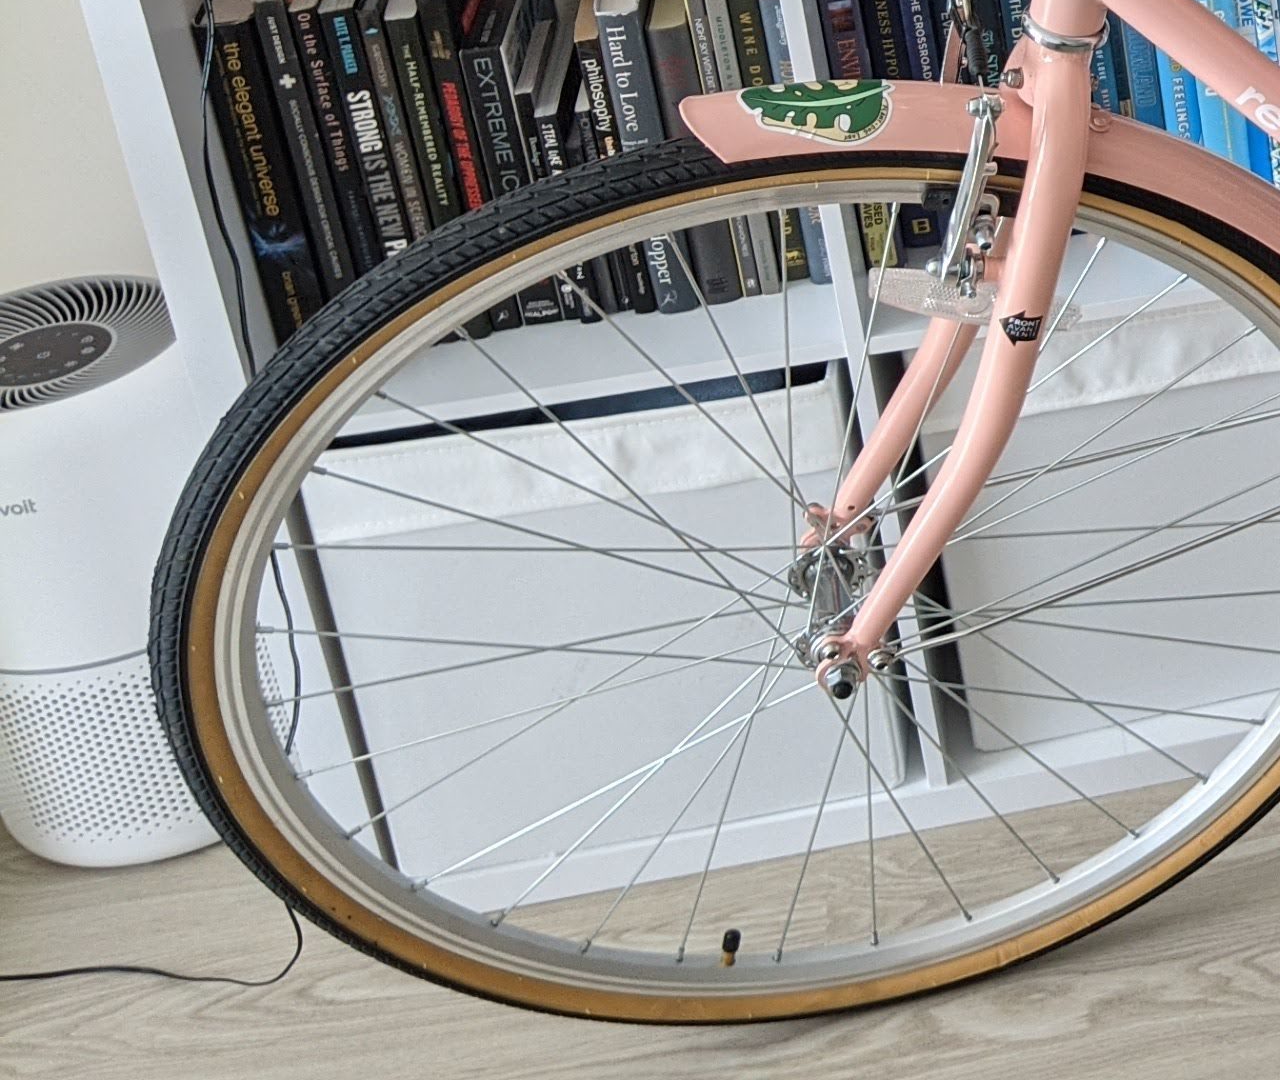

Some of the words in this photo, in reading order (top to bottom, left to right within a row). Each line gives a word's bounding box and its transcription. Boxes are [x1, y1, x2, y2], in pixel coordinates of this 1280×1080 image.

[297, 12, 310, 29] On
[694, 17, 706, 41] NIGHT
[1239, 3, 1254, 27] WE
[303, 34, 317, 55] the
[606, 25, 633, 68] Hard
[698, 41, 709, 55] SKY
[715, 16, 731, 69] MIDDLETON
[738, 11, 759, 56] WINE
[615, 71, 632, 88] to
[701, 55, 713, 74] WITH
[1097, 61, 1107, 80] LOVE
[310, 60, 331, 108] Surface
[581, 58, 613, 133] philosophy
[324, 113, 340, 126] of
[346, 89, 383, 153] STRONG
[473, 57, 515, 165] EXTREME
[620, 92, 639, 132] Love
[223, 42, 241, 70] the
[232, 75, 263, 141] elegant
[249, 145, 280, 216] universe
[405, 60, 438, 161] HALF-REMEMBERED
[431, 163, 449, 207] REALITY
[541, 123, 559, 148] STEAL
[330, 128, 349, 172] Things
[362, 153, 387, 170] IS
[394, 141, 415, 186] WOMEN
[548, 149, 563, 166] LIKE
[367, 172, 396, 203] THE
[375, 204, 406, 238] NEW
[1008, 317, 1041, 327] FRONT
